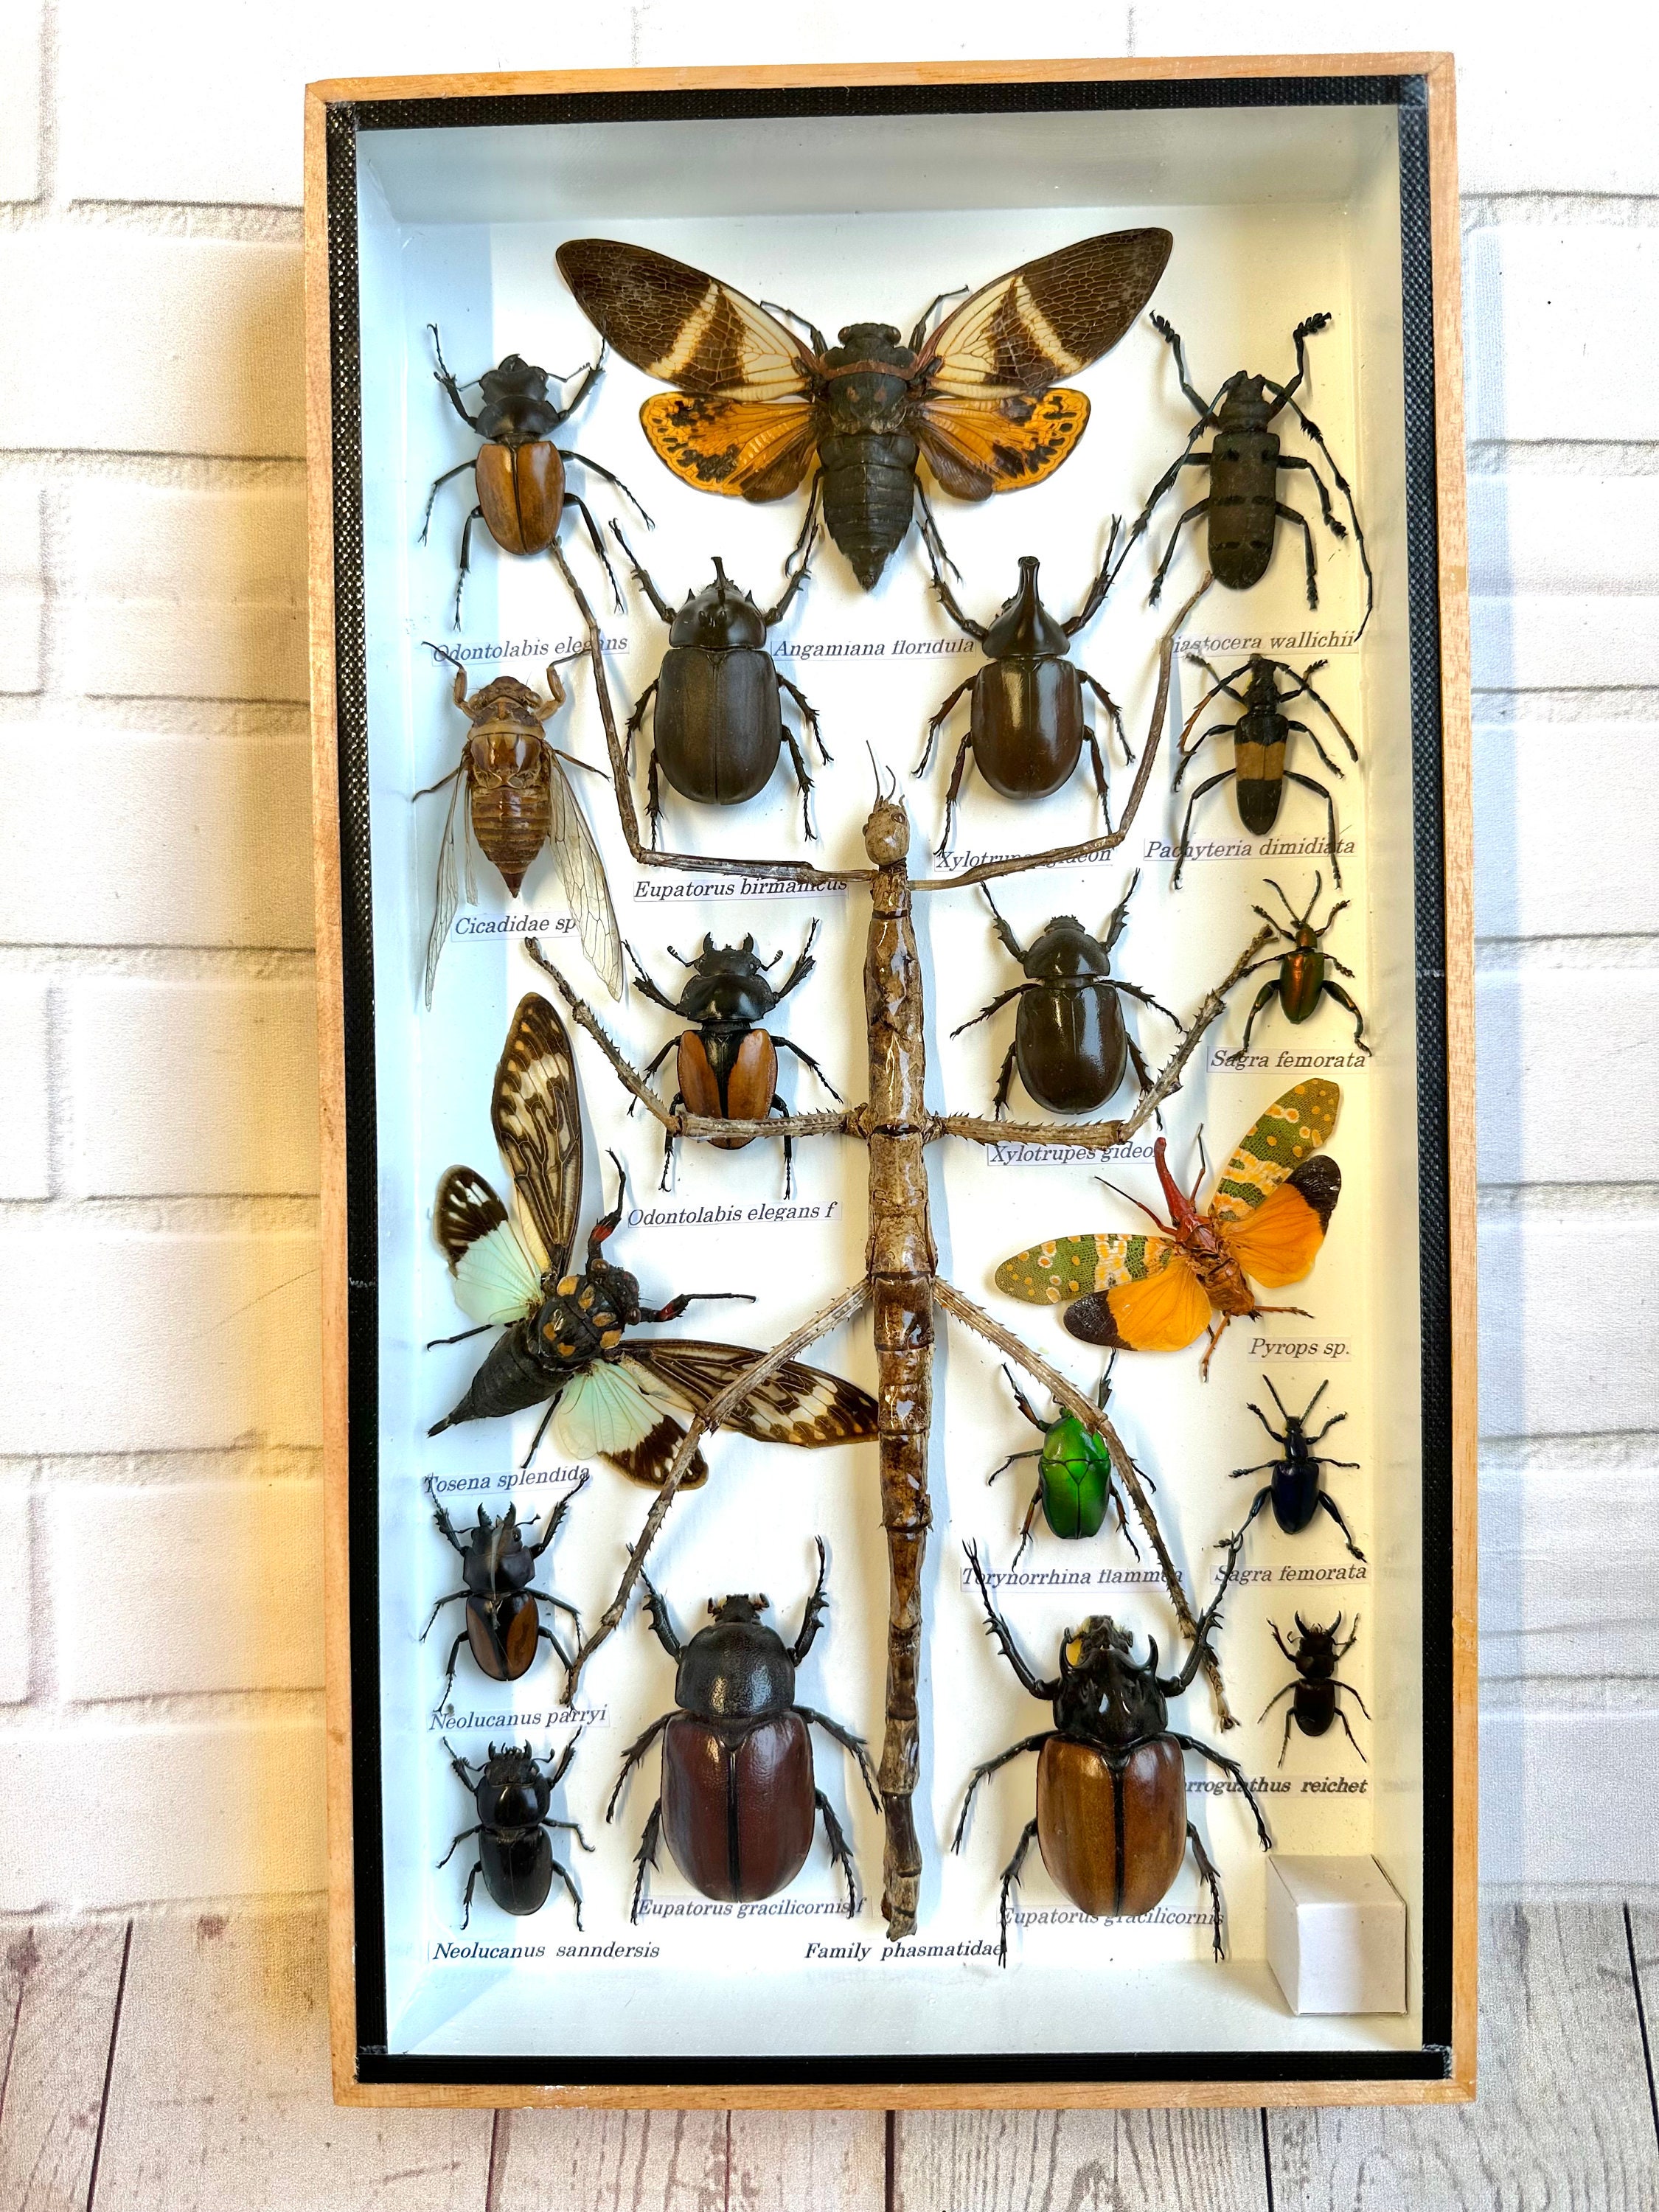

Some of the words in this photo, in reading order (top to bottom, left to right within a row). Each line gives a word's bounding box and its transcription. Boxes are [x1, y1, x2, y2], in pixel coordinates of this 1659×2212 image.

[434, 640, 549, 661] Odontolabis
[773, 640, 885, 660] Angamiana
[1173, 636, 1262, 653] iastocera
[1270, 631, 1354, 648] wallichii
[936, 850, 1032, 871] Xylotr
[634, 881, 734, 900] Eupatorus
[456, 915, 549, 934] Cicadidae
[1211, 1049, 1269, 1070] Sagra
[1275, 1051, 1366, 1068] femorata
[990, 1145, 1096, 1165] Xylotrupes
[1101, 1141, 1155, 1162] gideo
[628, 1205, 742, 1225] Odontolabis
[748, 1203, 821, 1221] elegans
[824, 1201, 838, 1218] f
[1248, 1338, 1318, 1358] Pyrops
[1324, 1343, 1349, 1358] sp.
[424, 1475, 490, 1493] Tosena
[497, 1465, 590, 1490] splendida
[1214, 1565, 1272, 1585] Sagra
[1278, 1564, 1367, 1581] femorata
[428, 1711, 541, 1731] Neolucanus
[545, 1703, 607, 1728] parryi
[637, 1899, 732, 1918] Eupatorus
[737, 1899, 849, 1919] gracilicornis
[997, 1907, 1099, 1927] Eupatorus
[433, 1942, 545, 1959] Neolucanus
[556, 1941, 660, 1958] sanndersis
[804, 1942, 872, 1961] Family
[880, 1939, 1002, 1961] phasmatidae
